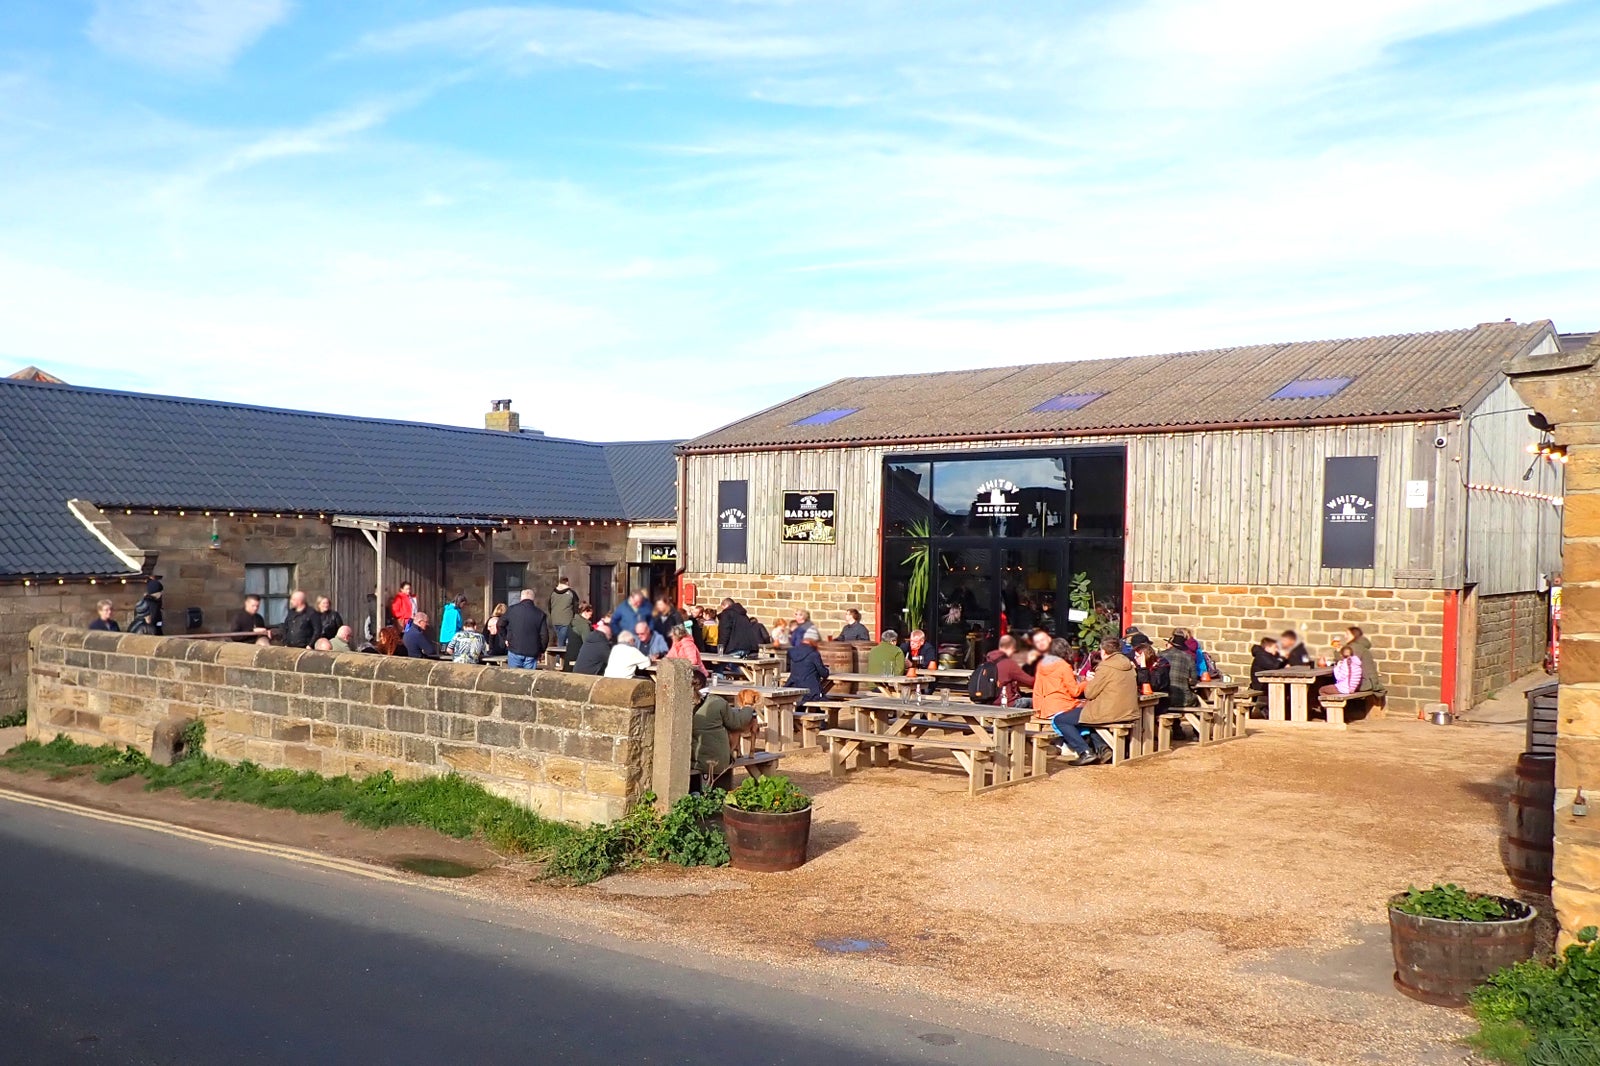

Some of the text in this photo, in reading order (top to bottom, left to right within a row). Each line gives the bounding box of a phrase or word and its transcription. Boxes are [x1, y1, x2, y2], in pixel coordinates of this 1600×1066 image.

[977, 479, 1020, 494] WHITBY
[1326, 494, 1374, 509] WHITBY
[719, 508, 746, 520] WHITBY
[784, 510, 803, 518] BAR
[810, 510, 834, 518] SHOP
